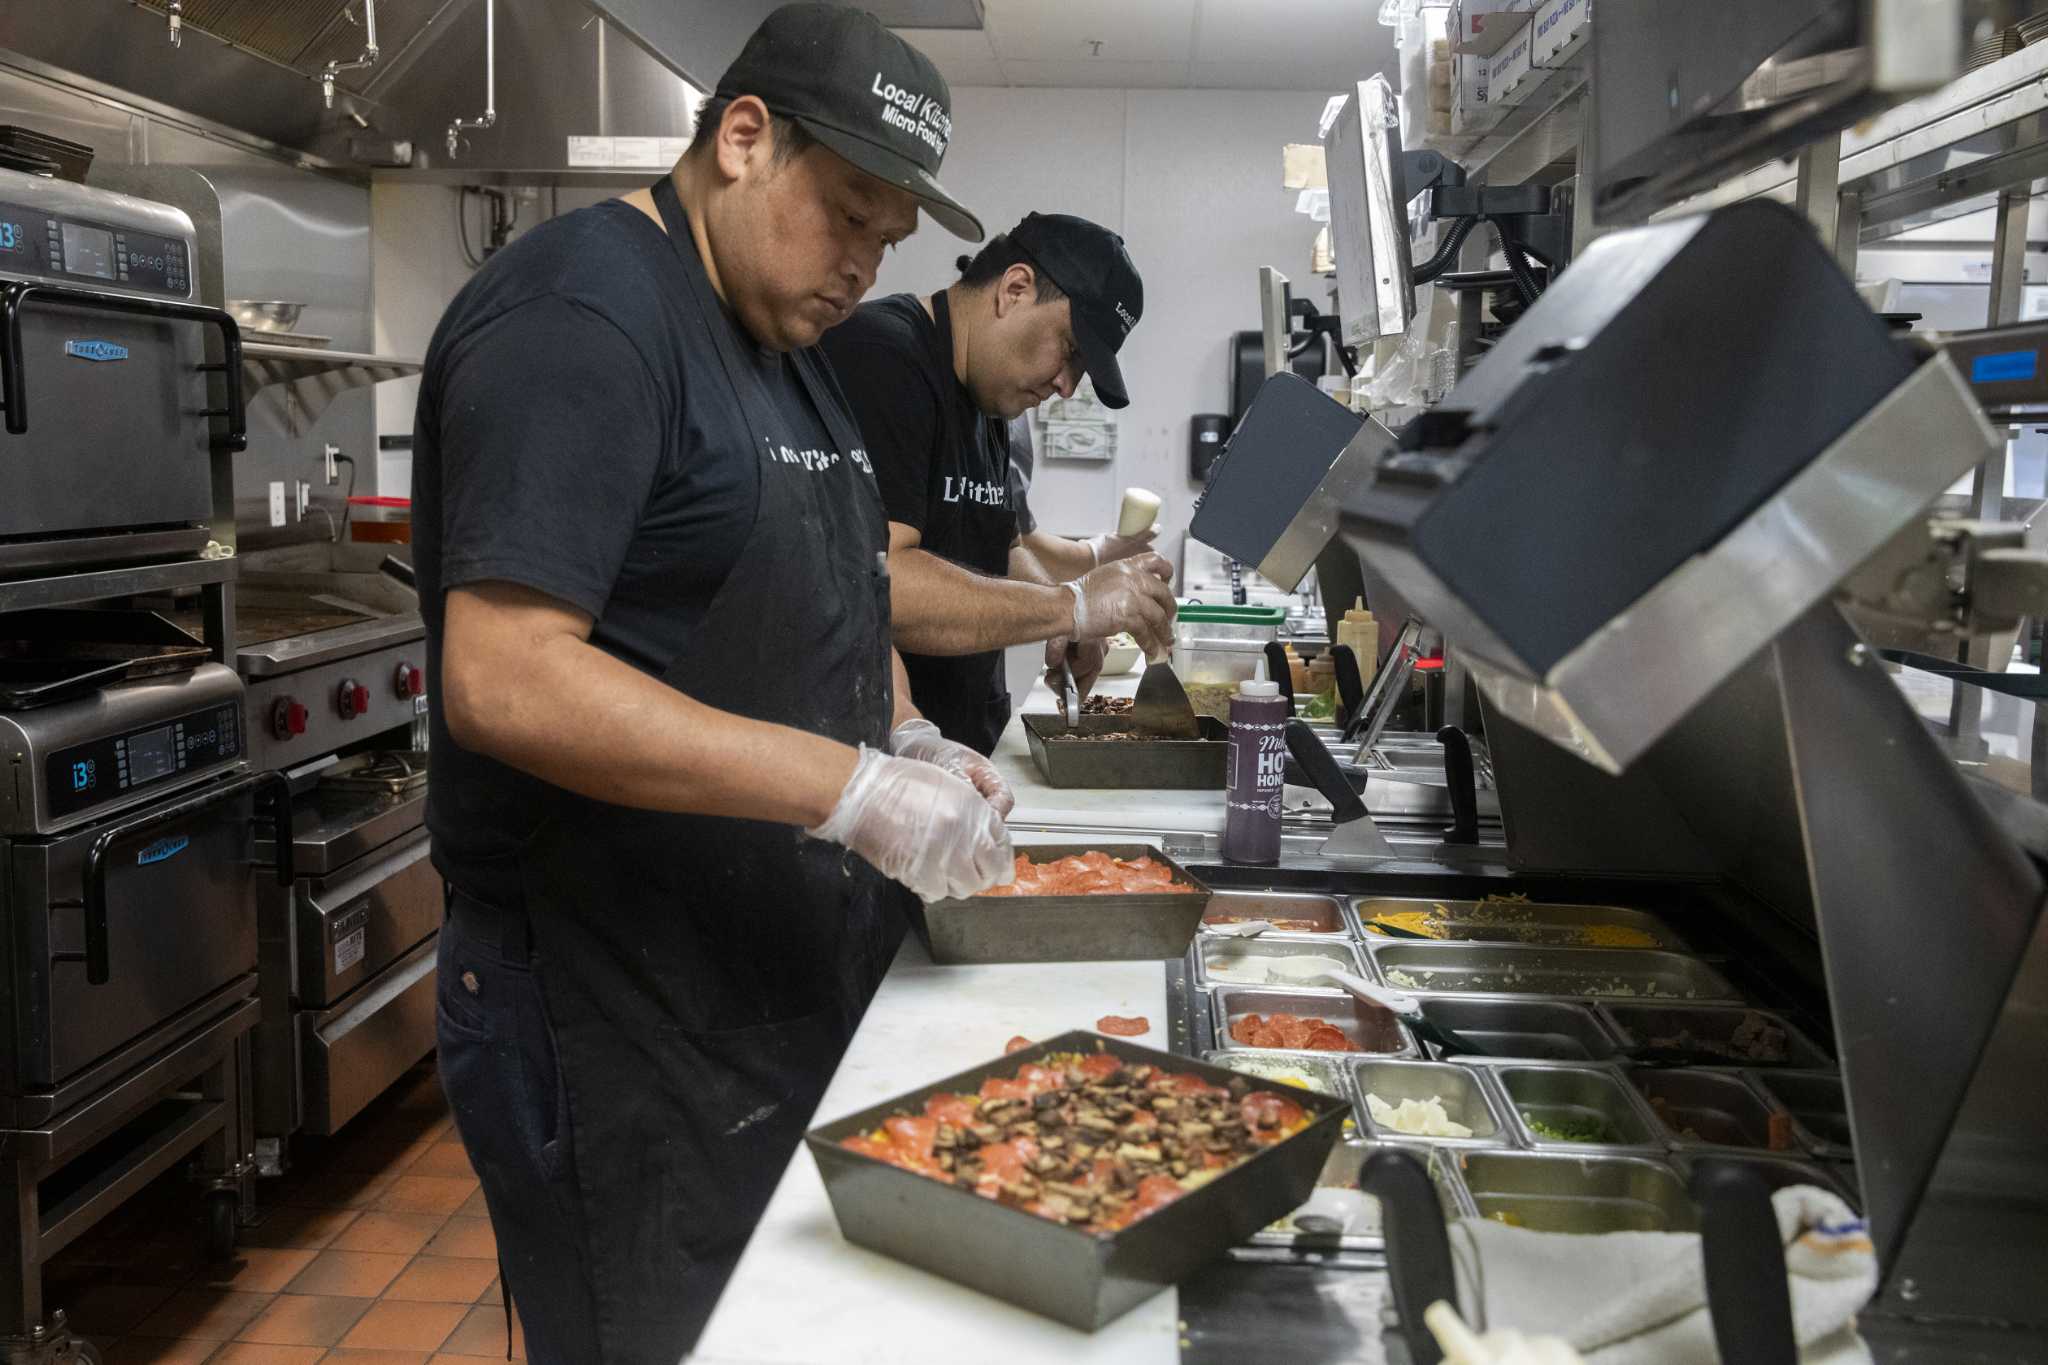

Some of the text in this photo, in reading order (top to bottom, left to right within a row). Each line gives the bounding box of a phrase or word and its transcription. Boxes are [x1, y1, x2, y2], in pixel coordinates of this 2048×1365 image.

[872, 72, 924, 114] Local
[881, 103, 916, 133] Micro
[73, 762, 88, 788] i3
